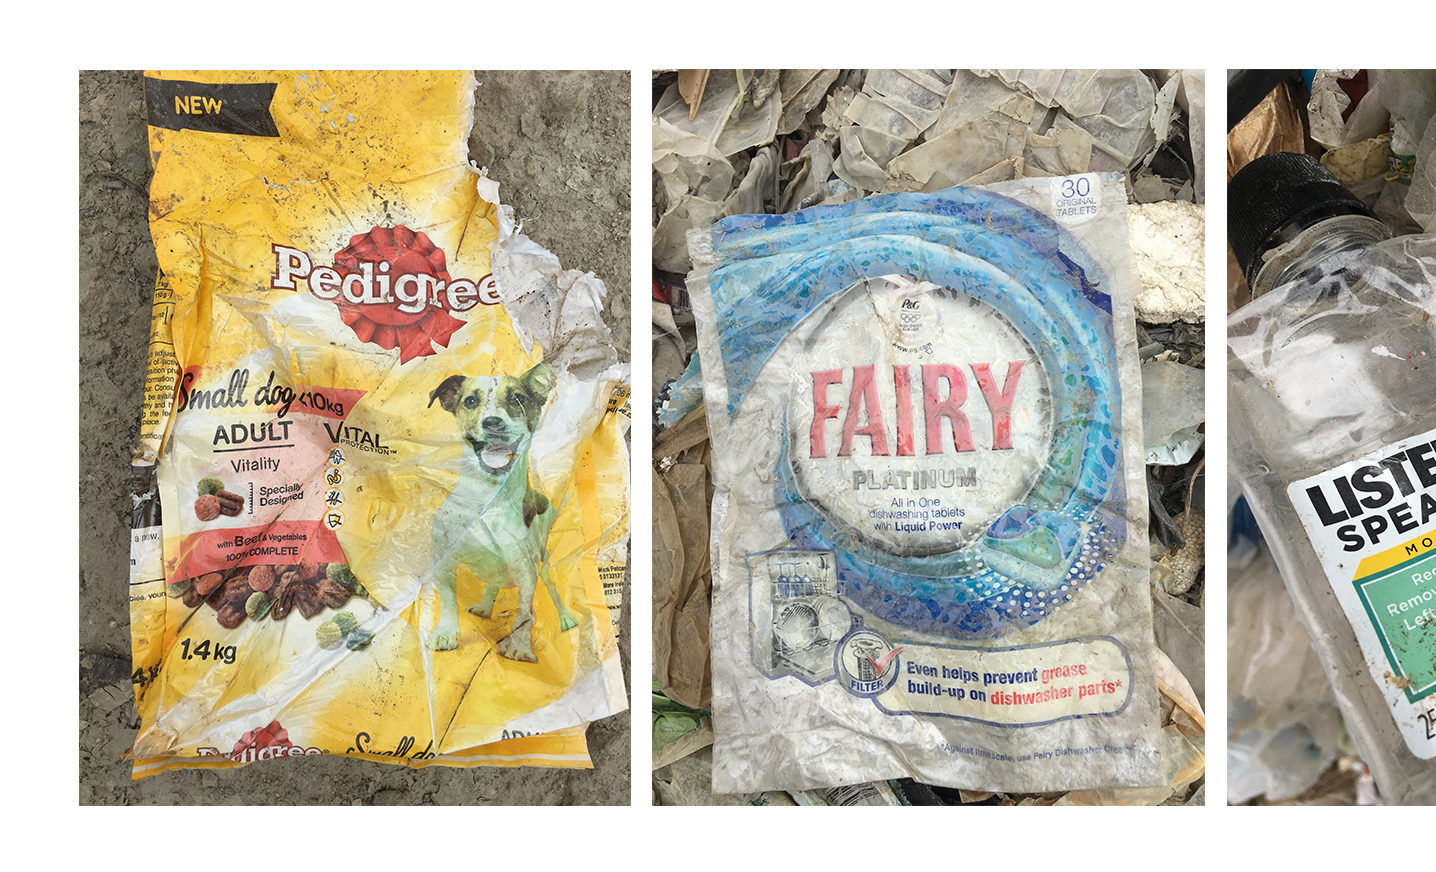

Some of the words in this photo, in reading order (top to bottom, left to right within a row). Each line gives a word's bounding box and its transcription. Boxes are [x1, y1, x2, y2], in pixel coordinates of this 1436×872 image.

[175, 95, 222, 115] NEW
[1062, 177, 1090, 198] 30
[1056, 197, 1096, 207] ORIGINAL
[1056, 206, 1097, 216] TABLETS
[271, 243, 502, 315] Pedigree
[901, 298, 920, 310] P&G
[177, 368, 249, 413] Small
[254, 370, 296, 418] dog
[299, 391, 345, 416] <10kg
[809, 360, 1027, 459] FAIRY
[213, 420, 294, 446] ADULT
[323, 421, 389, 449] VITAL
[231, 457, 280, 473] Vitality
[852, 466, 977, 490] PLATINUM
[259, 483, 304, 496] Specially
[260, 491, 304, 507] Designed
[890, 497, 904, 507] All
[906, 497, 915, 507] in
[918, 497, 941, 508] One
[869, 508, 929, 520] dishwashing
[931, 507, 965, 518] tablets
[873, 522, 892, 531] with
[895, 522, 927, 534] Liquid
[929, 521, 963, 531] Power
[217, 540, 233, 549] with
[234, 532, 263, 547] Beef
[268, 534, 307, 543] Vegetables
[248, 547, 299, 560] COMPLETE
[1403, 607, 1436, 631] Left
[180, 638, 211, 661] 1.4
[213, 641, 237, 664] kg
[907, 661, 938, 677] Even
[942, 664, 979, 682] helps
[983, 668, 1038, 687] prevent
[1041, 663, 1087, 684] grease
[850, 679, 884, 692] FILTER
[907, 680, 966, 700] build-up
[969, 688, 986, 702] on
[990, 684, 1074, 706] dishwasher
[1033, 750, 1054, 760] Fairy
